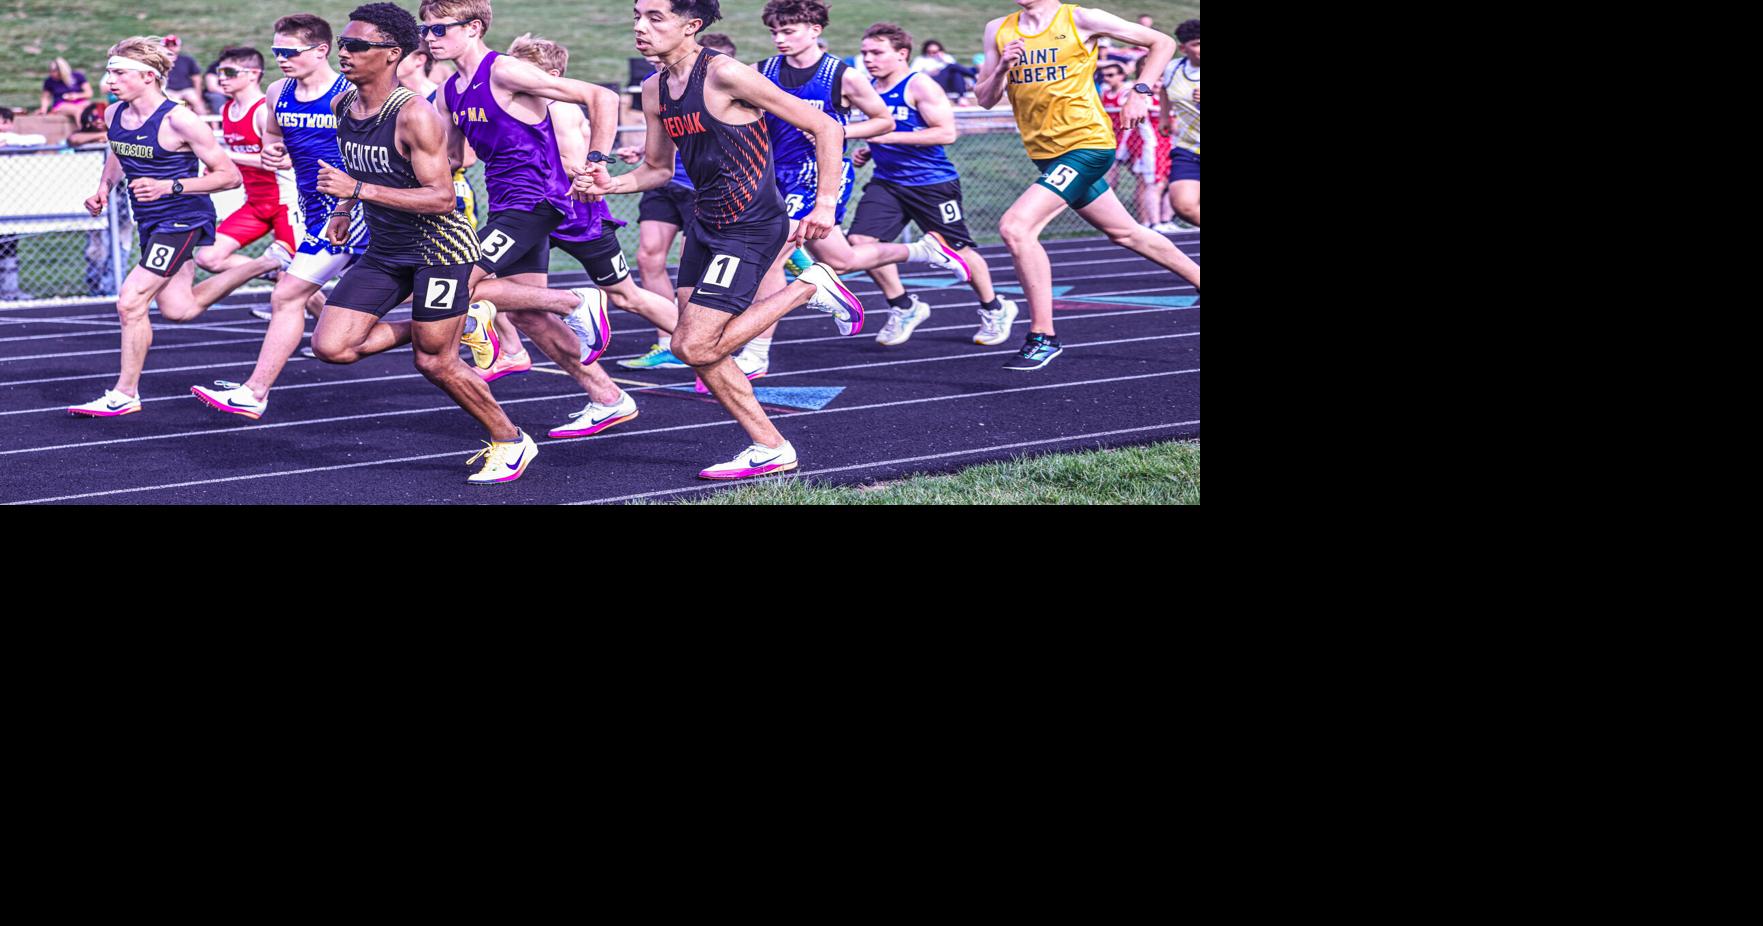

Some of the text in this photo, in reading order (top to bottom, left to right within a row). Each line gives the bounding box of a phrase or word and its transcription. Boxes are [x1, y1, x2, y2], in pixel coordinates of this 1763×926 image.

[1014, 48, 1058, 66] AINT
[1009, 65, 1067, 85] ALBERT
[111, 141, 154, 159] VERSIDE
[345, 141, 393, 173] CENTER
[1051, 166, 1073, 186] 5
[944, 203, 956, 221] 9
[482, 233, 508, 257] 3
[151, 247, 169, 268] 8
[618, 254, 629, 273] 4
[716, 257, 731, 284] 1
[431, 280, 451, 307] 2
